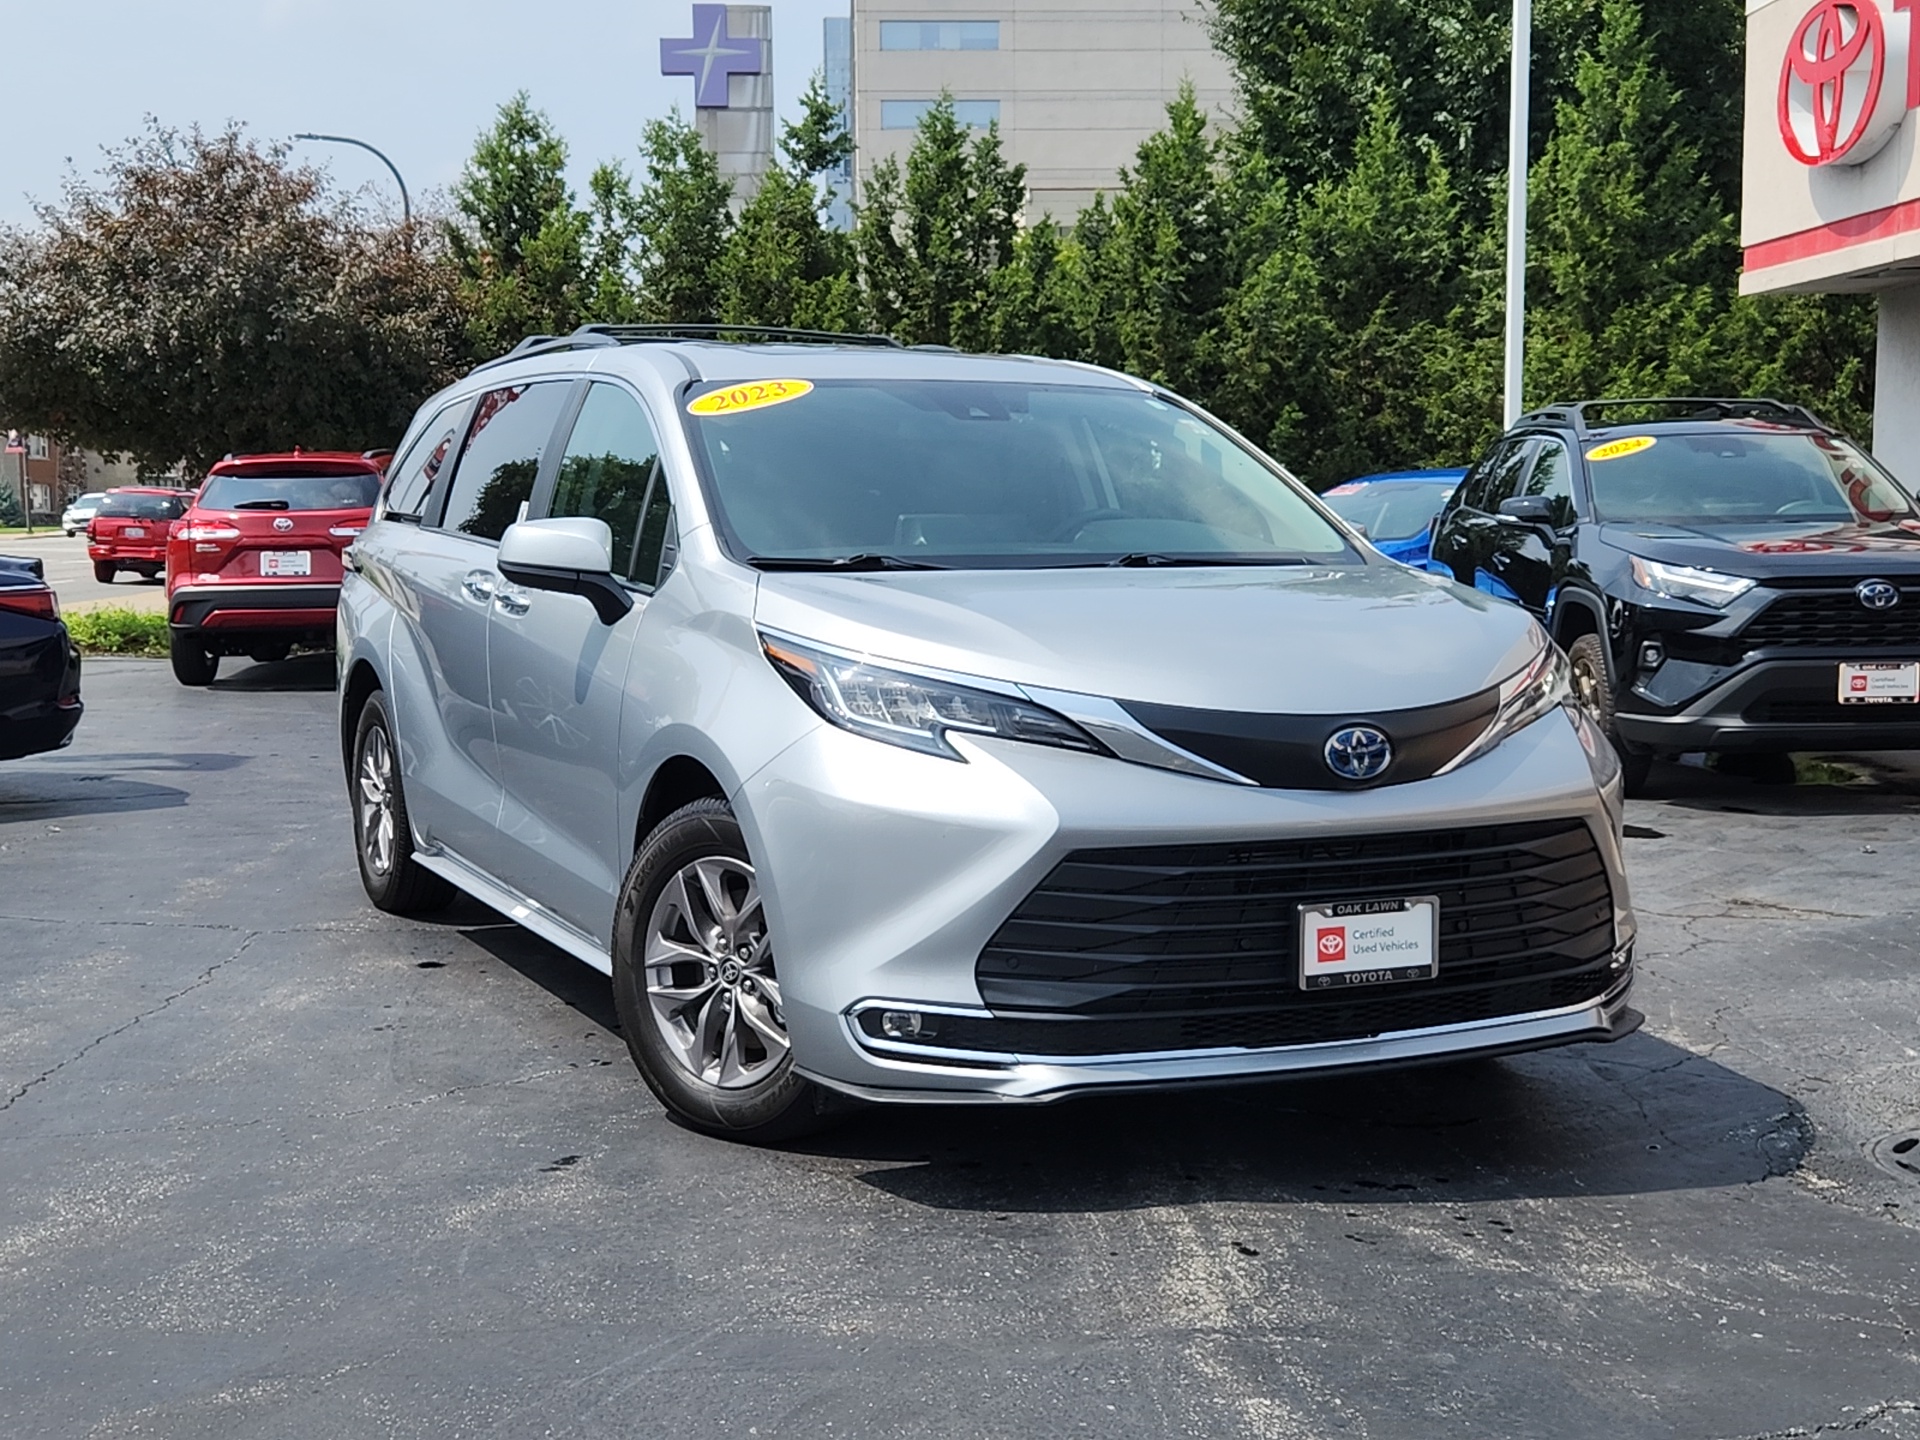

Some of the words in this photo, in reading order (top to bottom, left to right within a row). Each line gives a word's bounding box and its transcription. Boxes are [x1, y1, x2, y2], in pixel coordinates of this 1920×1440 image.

[710, 381, 788, 411] 2023
[1601, 439, 1642, 457] 2024
[1336, 903, 1362, 915] OAK
[1365, 901, 1399, 913] LAWN
[1352, 927, 1394, 940] Certified
[1353, 943, 1377, 954] Used
[1379, 940, 1419, 952] Vehicles
[1344, 970, 1393, 984] TOYOTA
